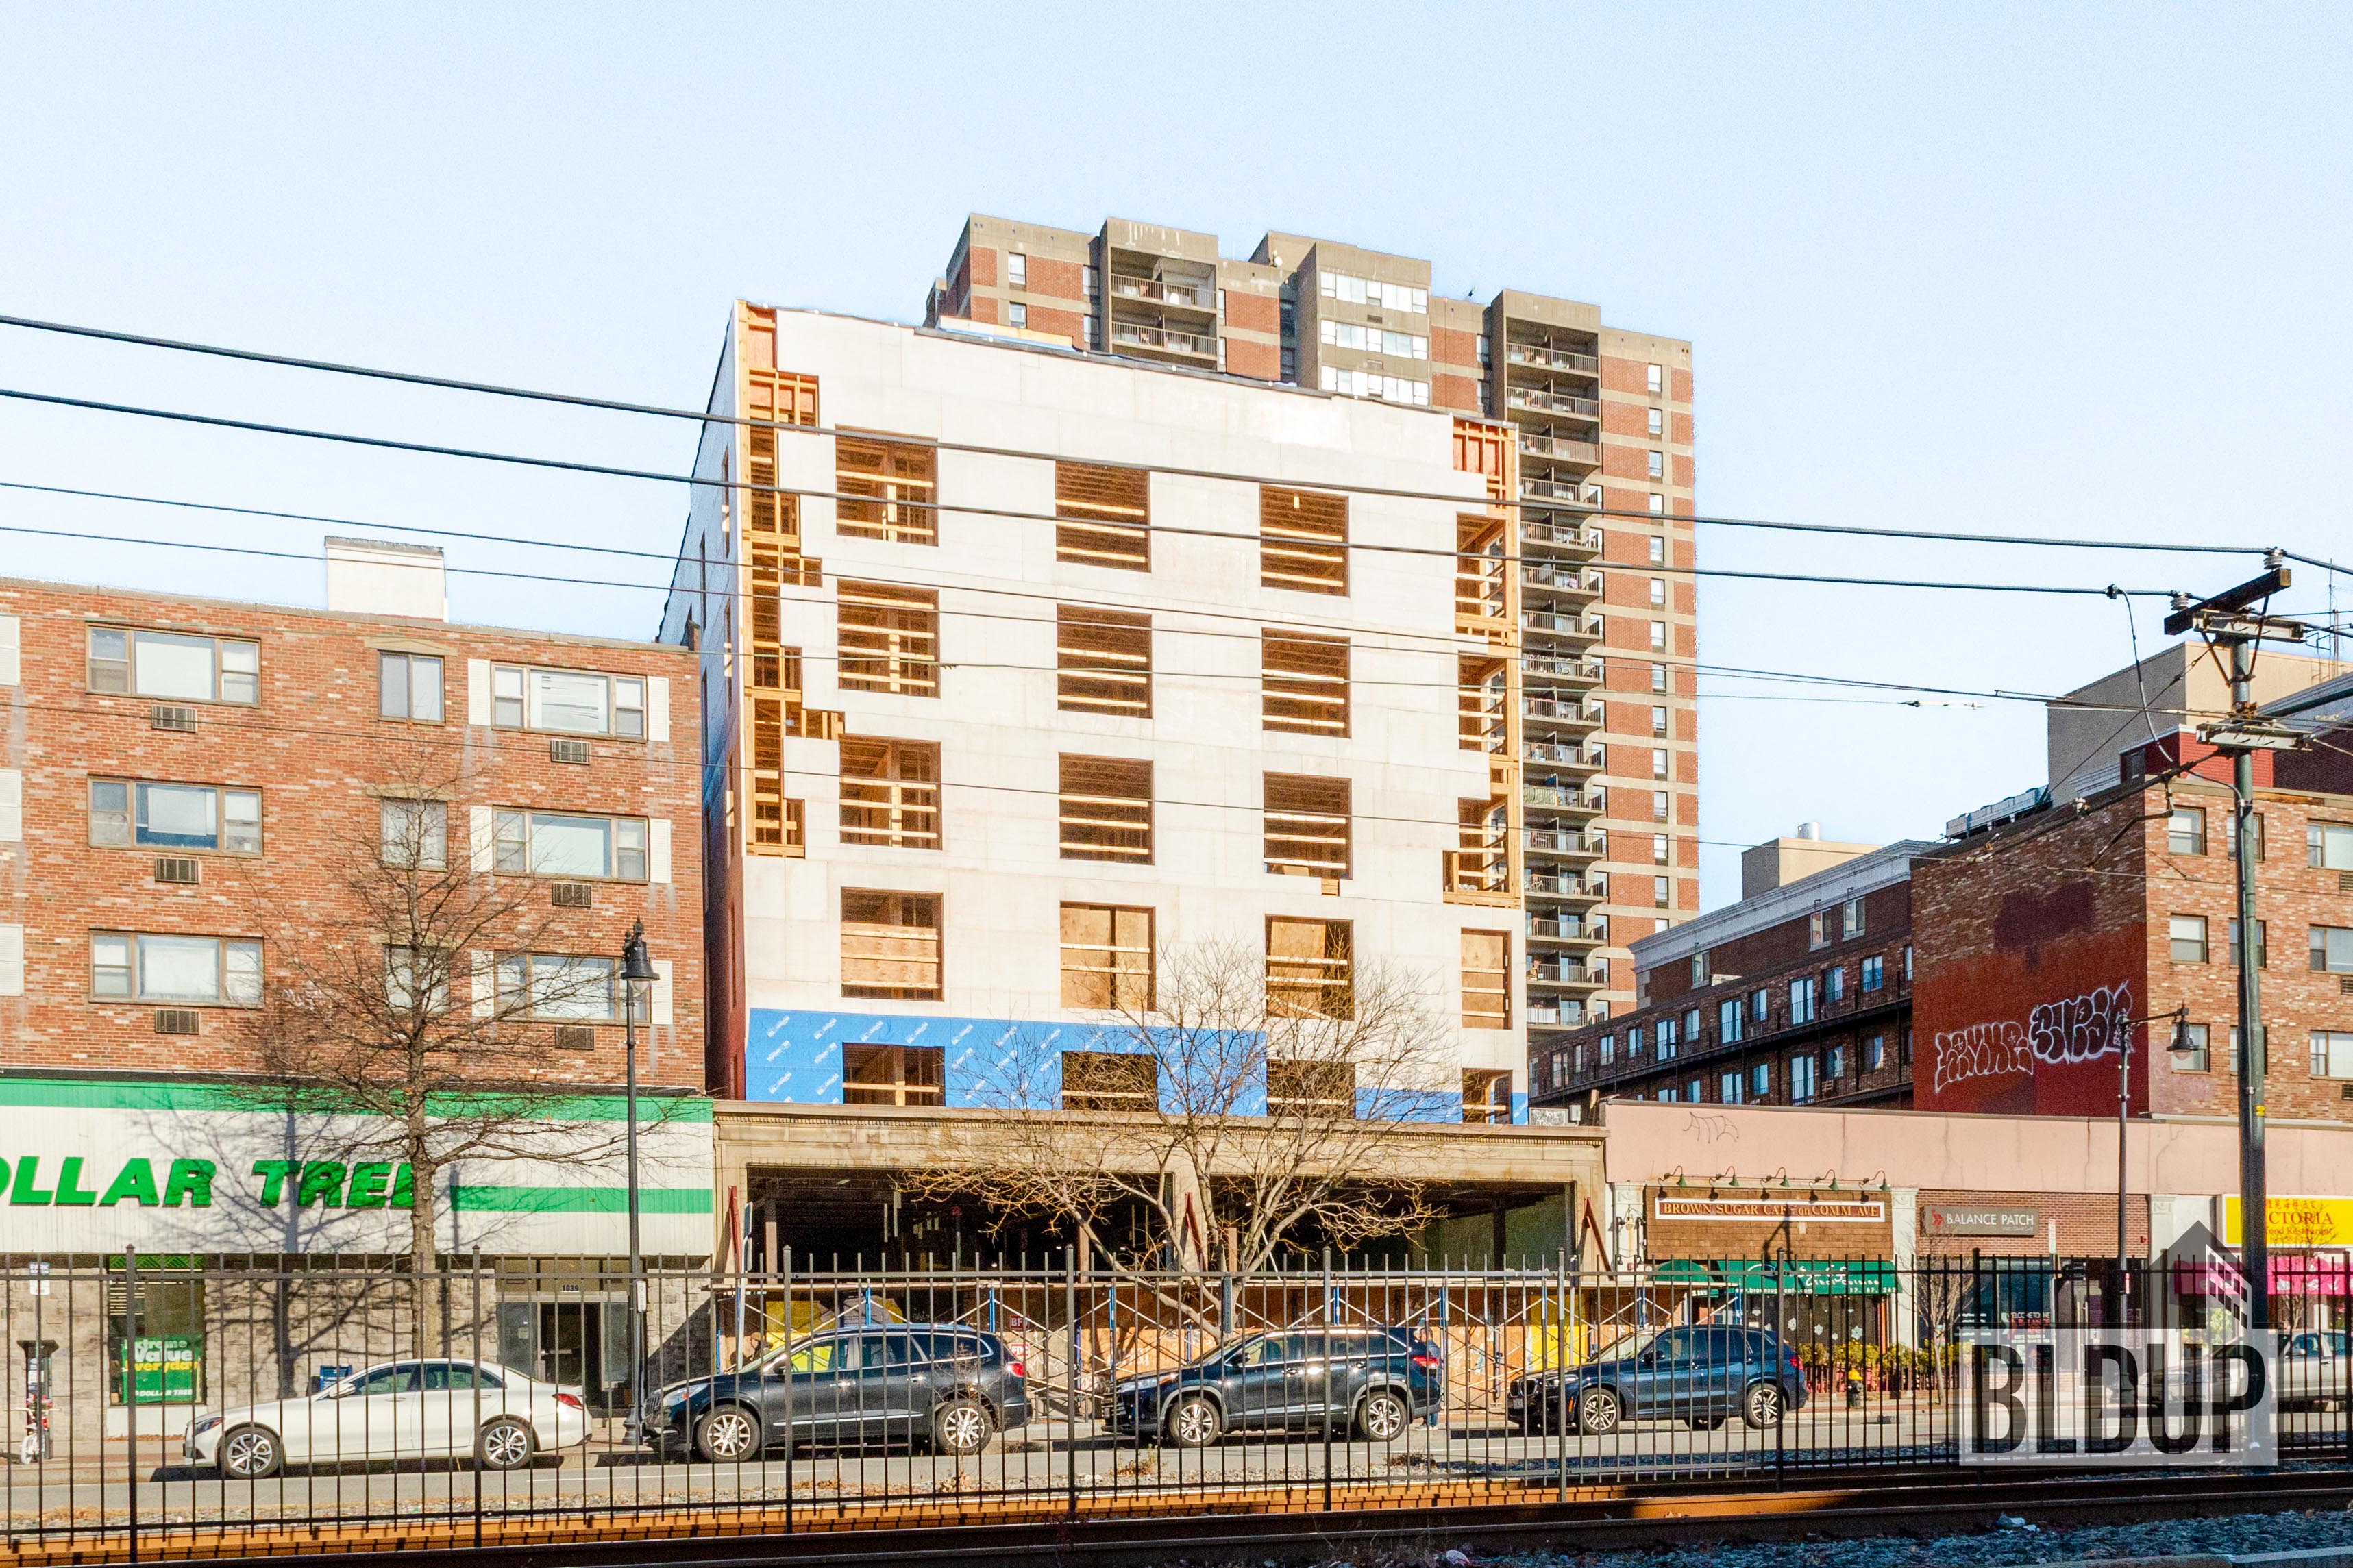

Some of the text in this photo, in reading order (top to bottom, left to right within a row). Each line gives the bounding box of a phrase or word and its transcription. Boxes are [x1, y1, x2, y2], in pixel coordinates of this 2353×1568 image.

[0, 1156, 216, 1208] LLAR
[1663, 1203, 1711, 1215] BROWN
[1715, 1204, 1759, 1215] SUGAR
[1798, 1206, 1810, 1216] on
[1812, 1204, 1851, 1216] COMM
[1857, 1206, 1878, 1217] AVE
[1947, 1213, 2034, 1225] BALANCE PATCH
[2269, 1211, 2333, 1225] CTORIA
[132, 1345, 193, 1362] Value
